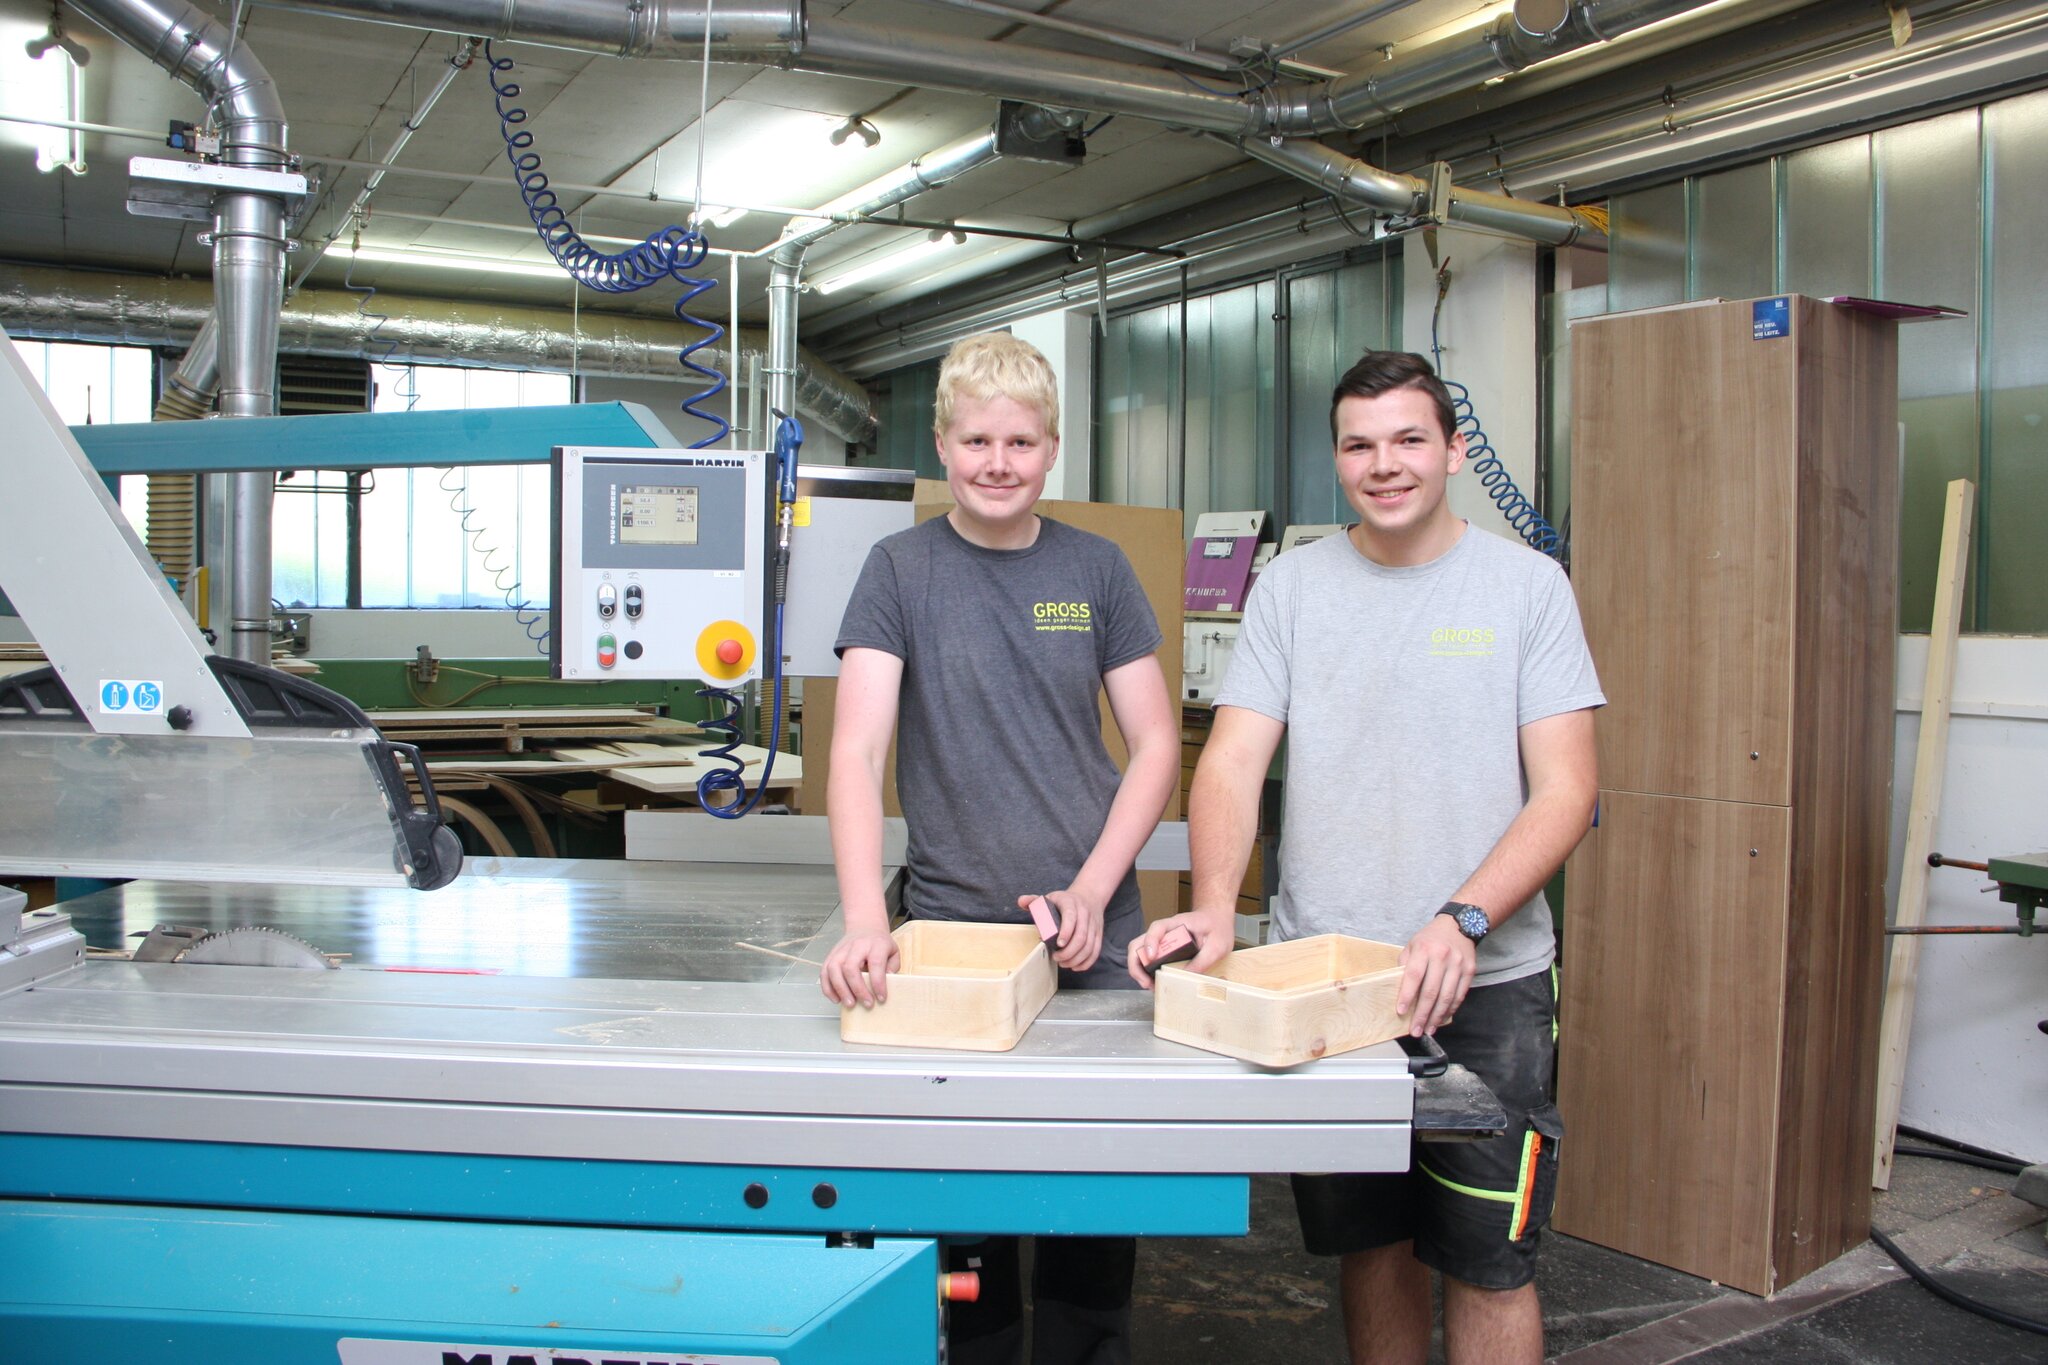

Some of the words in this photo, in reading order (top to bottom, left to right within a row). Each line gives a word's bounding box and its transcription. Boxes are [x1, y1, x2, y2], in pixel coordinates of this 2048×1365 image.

[695, 459, 744, 467] MARTIN
[1033, 602, 1091, 618] GROSS
[1431, 628, 1494, 643] GROSS
